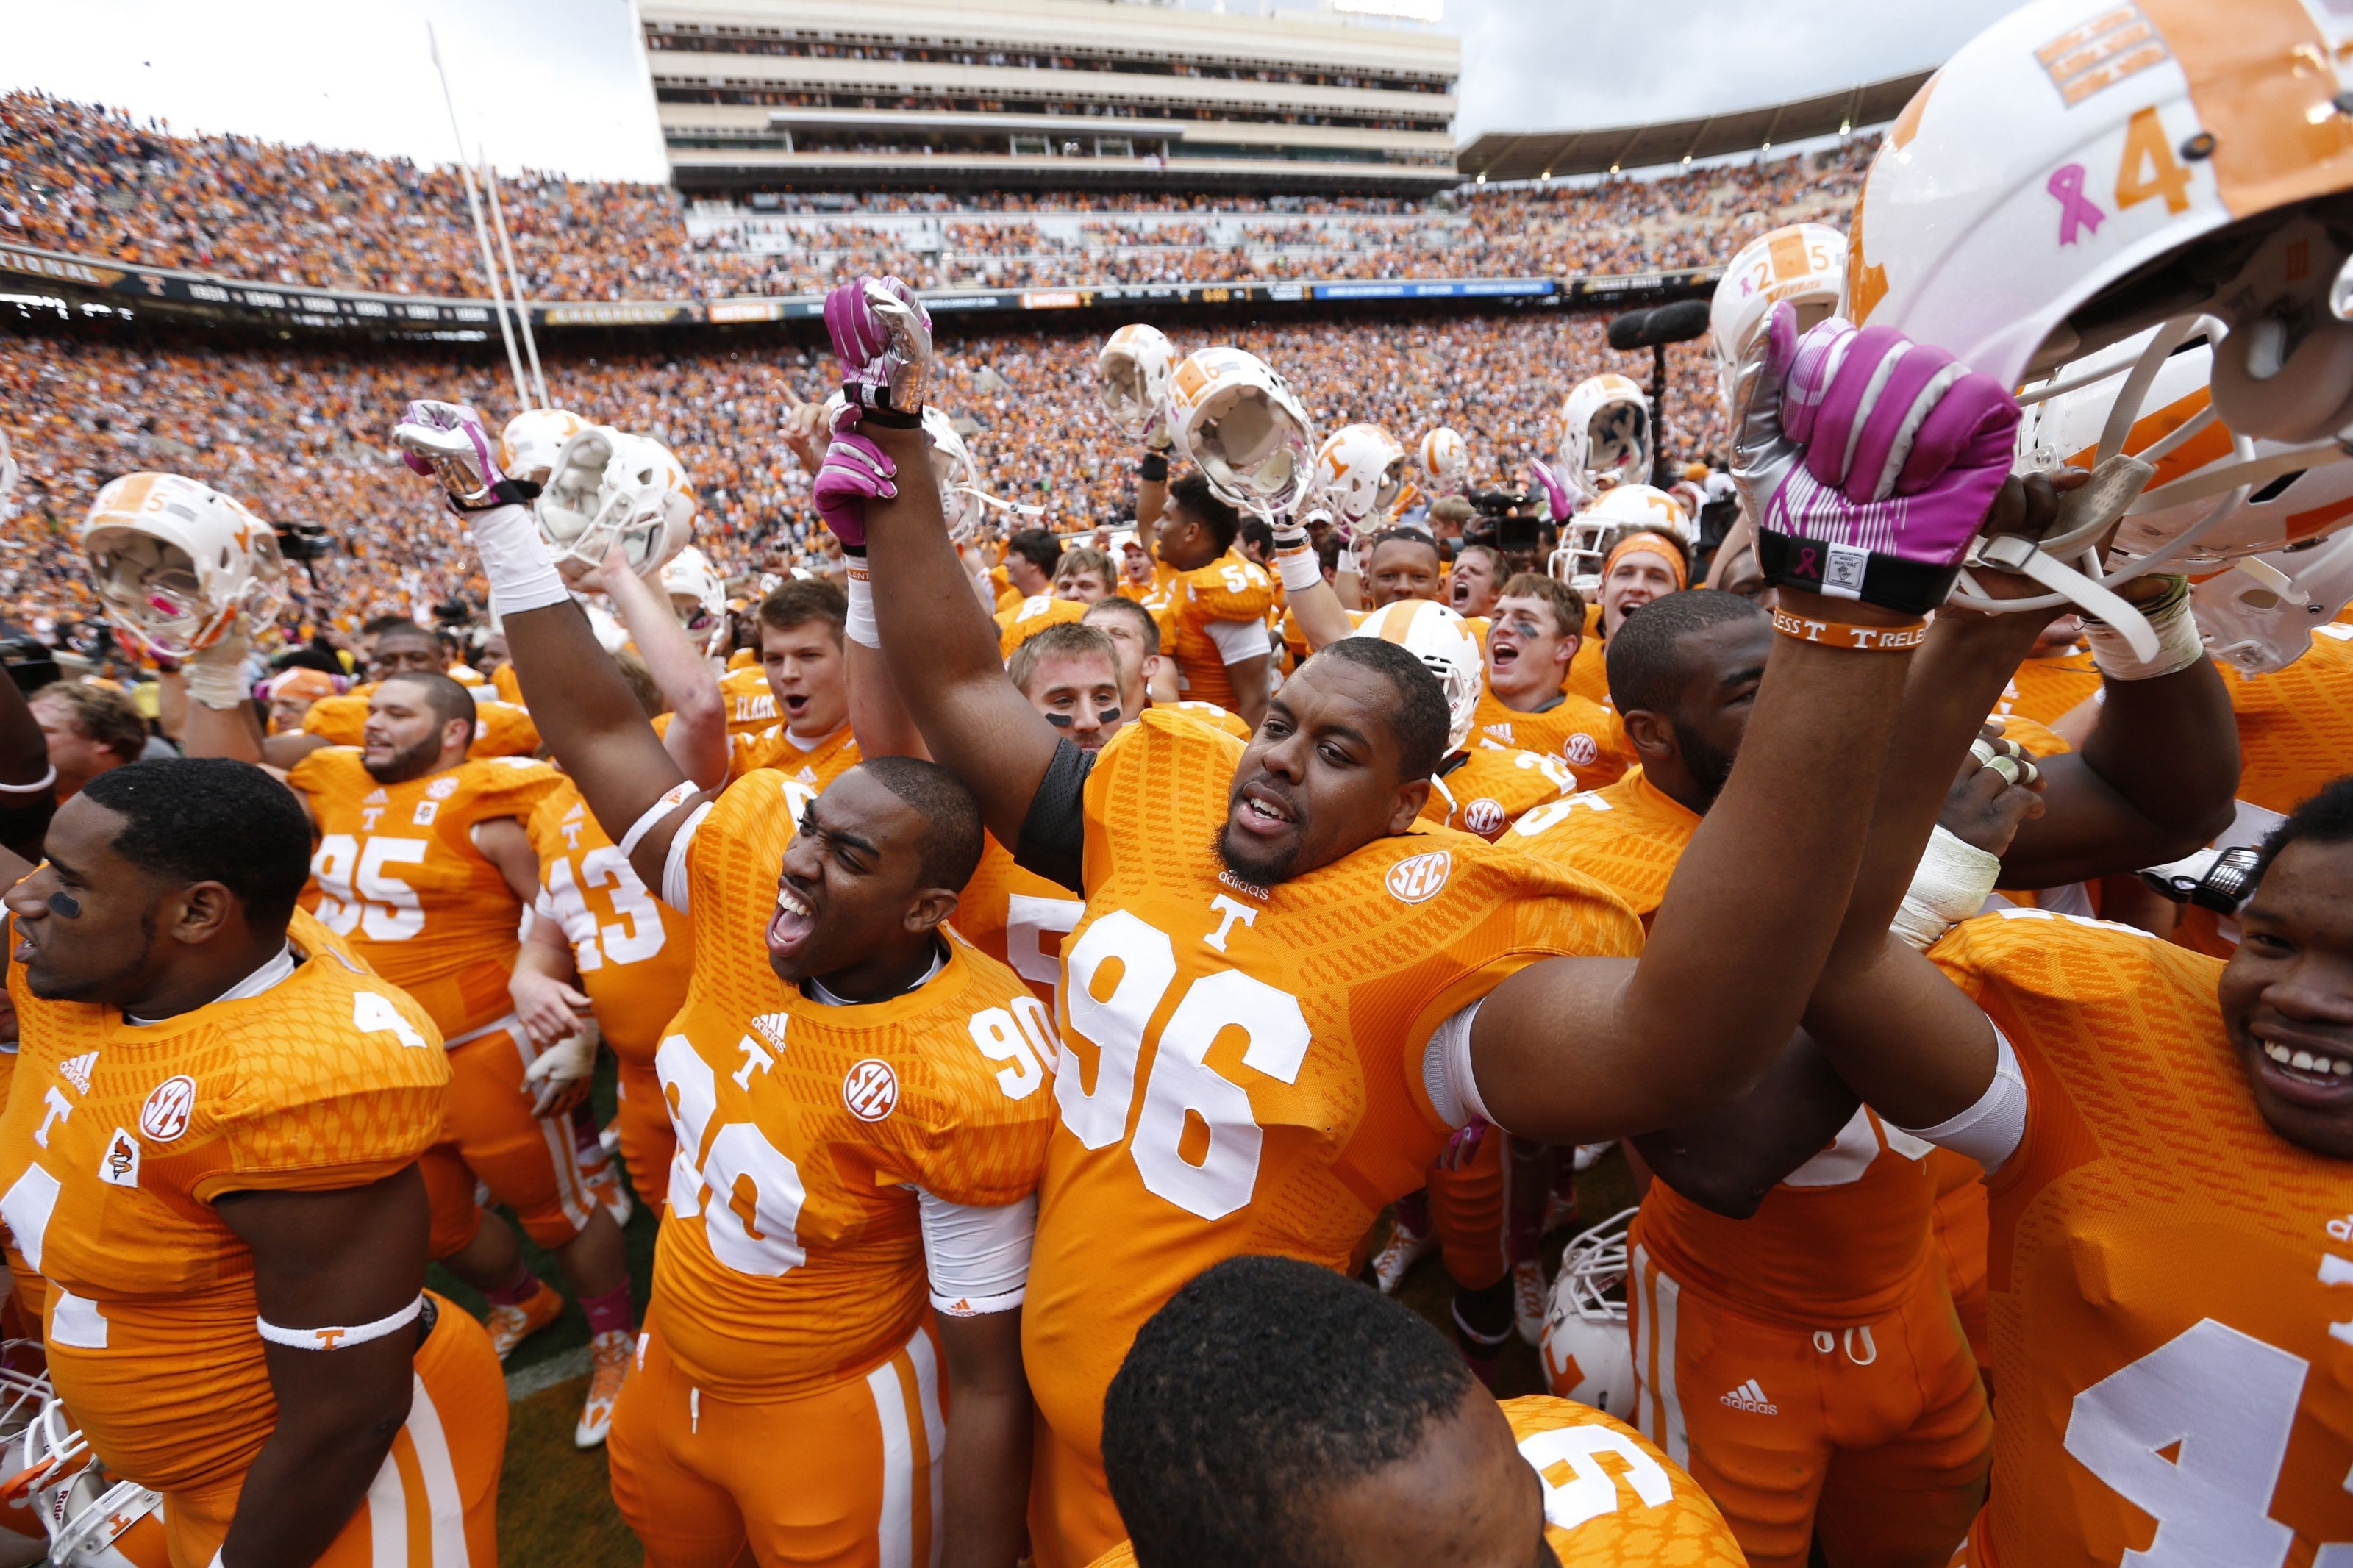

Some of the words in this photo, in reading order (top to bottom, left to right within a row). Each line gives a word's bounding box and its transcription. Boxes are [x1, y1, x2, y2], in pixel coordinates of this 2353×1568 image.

[2114, 105, 2193, 216] 4
[1219, 563, 1268, 594] 54
[735, 693, 777, 721] CLARK
[1482, 726, 1516, 745] adidas
[1564, 735, 1596, 764] SEC
[1466, 803, 1503, 831] SEC
[310, 834, 428, 941] 95
[1387, 852, 1451, 901] SEC
[1202, 893, 1259, 953] T
[751, 1015, 787, 1053] adidas
[968, 995, 1061, 1100] 90
[59, 1060, 91, 1095] adidas
[732, 1034, 774, 1092] T
[1054, 908, 1313, 1222] 96
[35, 1086, 74, 1149] T
[143, 1079, 191, 1137] SEC
[847, 1064, 895, 1118] SEC
[654, 1034, 807, 1278] 90
[315, 1330, 344, 1350] T
[1719, 1395, 1778, 1416] adidas
[2064, 1317, 2353, 1568] 4
